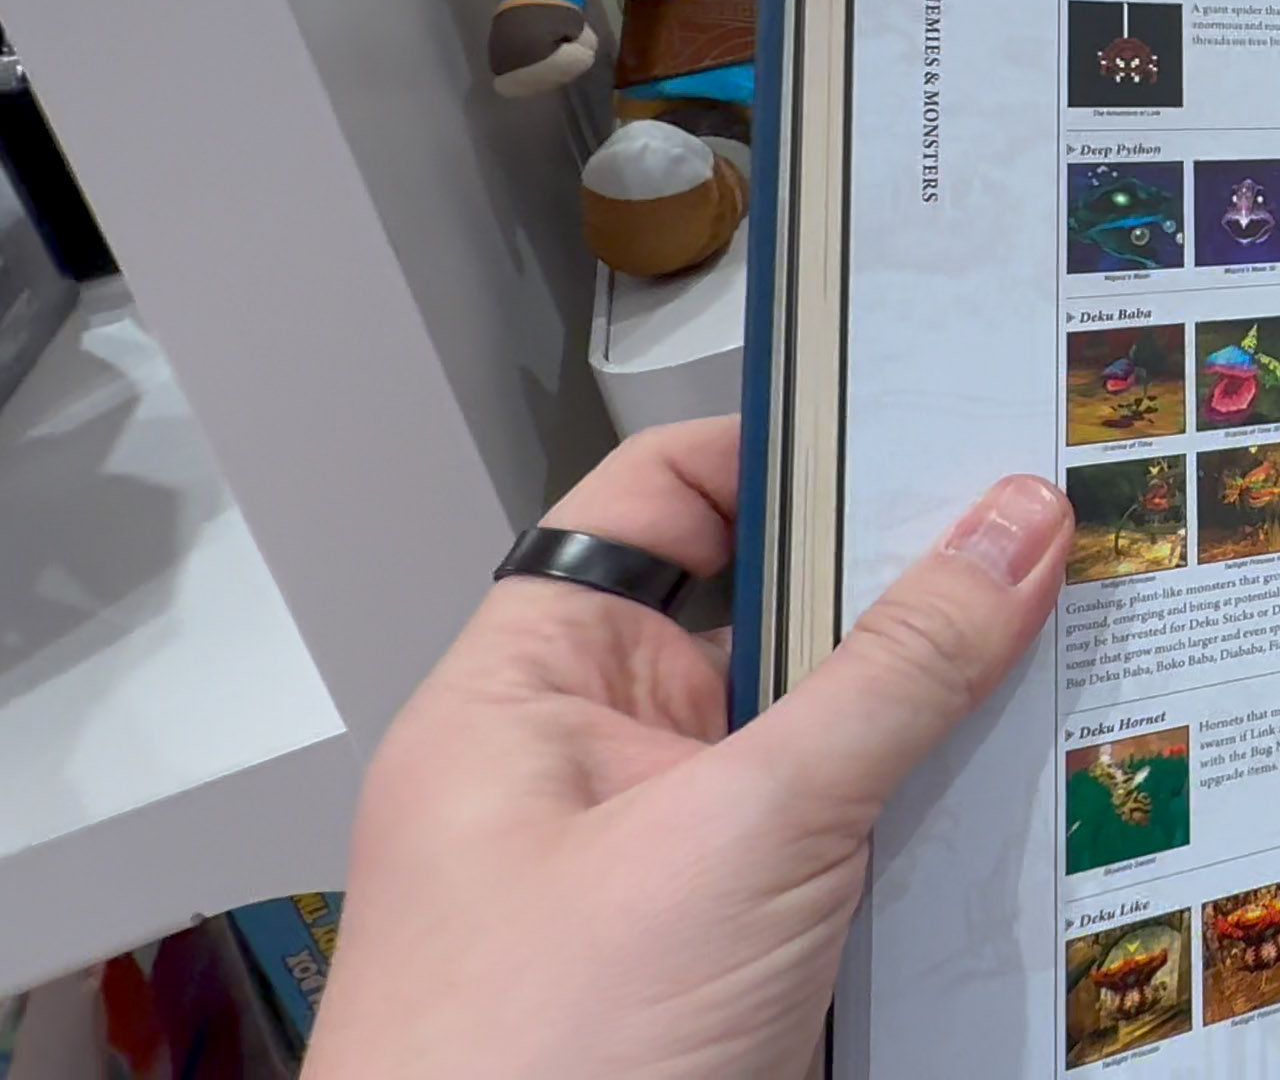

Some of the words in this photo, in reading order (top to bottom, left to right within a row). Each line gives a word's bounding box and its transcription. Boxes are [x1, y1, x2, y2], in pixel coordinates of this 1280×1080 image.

[925, 71, 938, 86] &
[922, 90, 939, 203] MONSTERS
[1079, 144, 1112, 158] Deep
[1116, 142, 1160, 155] Python
[1079, 310, 1113, 323] Deku
[1117, 307, 1151, 320] Baba
[1129, 586, 1182, 607] plant-like
[1185, 580, 1236, 595] monsters
[1238, 574, 1260, 585] that
[1066, 657, 1096, 669] some
[1099, 652, 1121, 664] that
[1123, 647, 1152, 663] grow
[1154, 638, 1185, 654] much
[1187, 635, 1218, 649] larger
[1220, 627, 1240, 642] and
[1242, 627, 1267, 638] even
[1078, 722, 1114, 739] Deku
[1118, 711, 1165, 731] Hornet
[1199, 716, 1244, 732] Hornets
[1246, 710, 1267, 722] that
[1199, 767, 1244, 789] upgrade
[1079, 909, 1115, 927] Deku
[1119, 900, 1149, 916] Like
